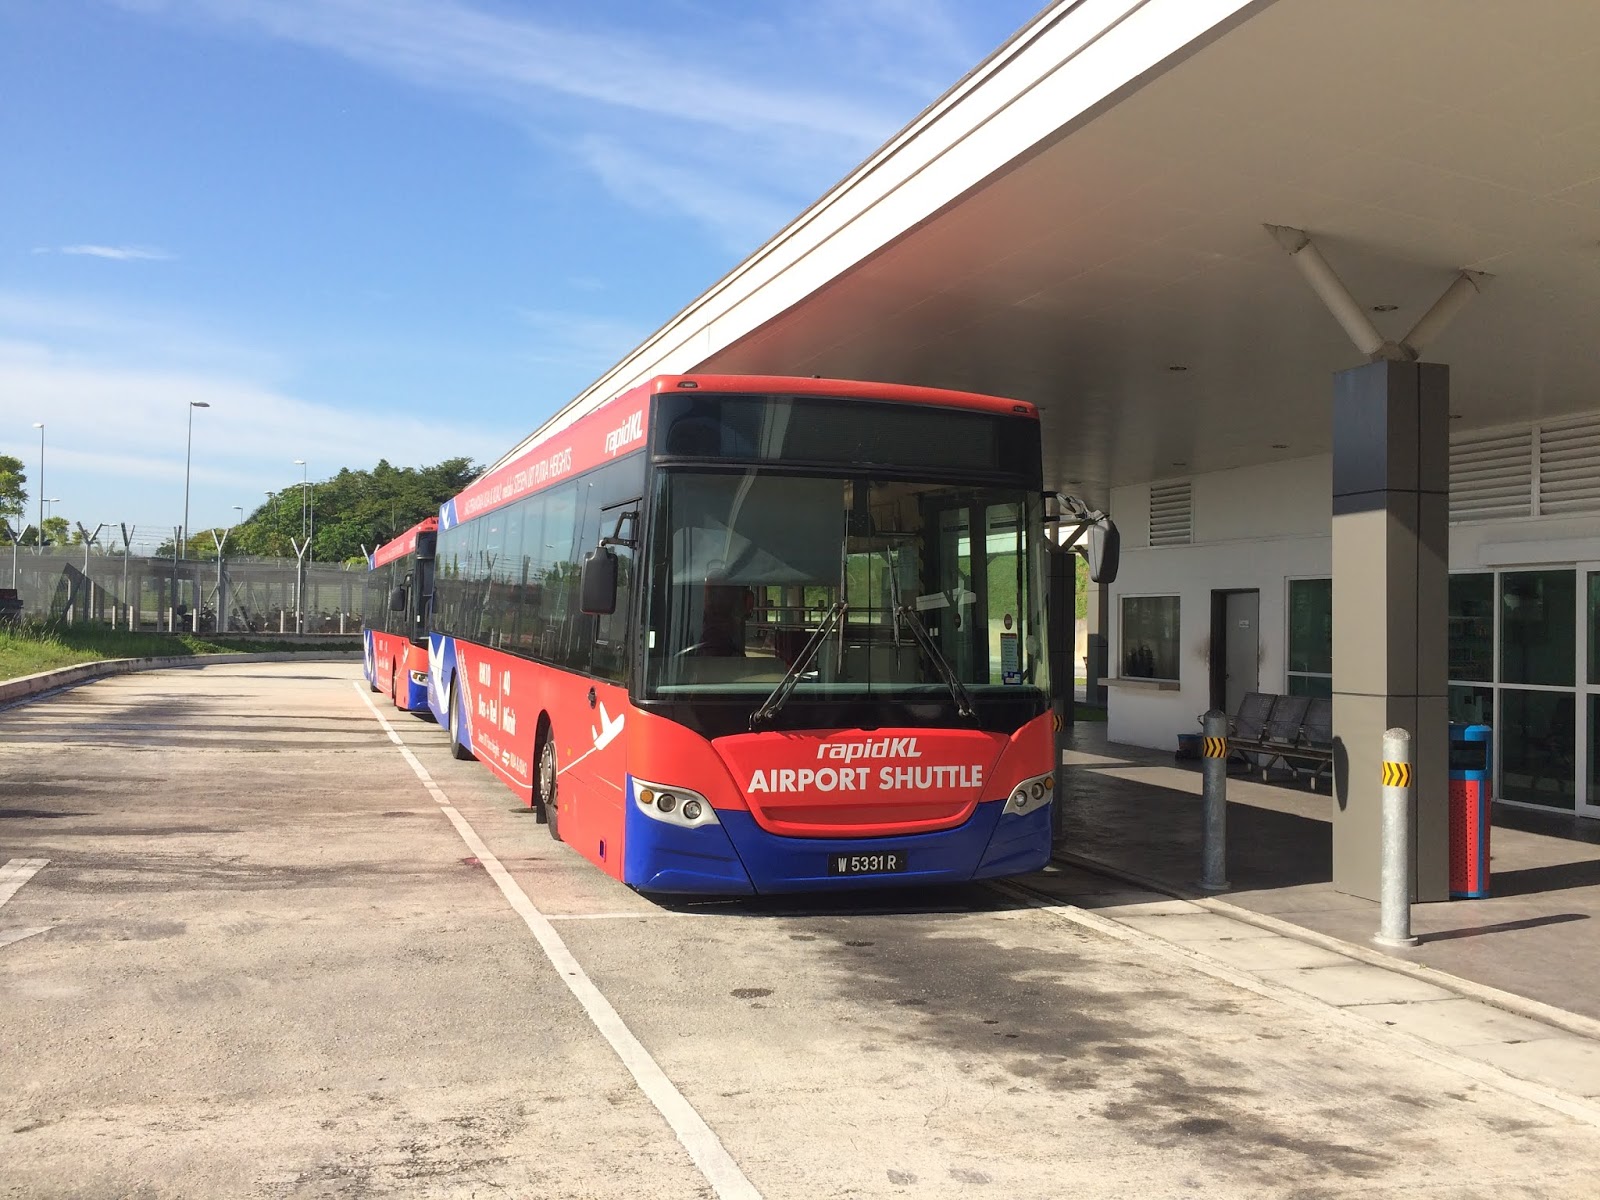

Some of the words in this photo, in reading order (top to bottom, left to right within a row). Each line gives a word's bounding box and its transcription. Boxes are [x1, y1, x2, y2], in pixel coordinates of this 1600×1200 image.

[605, 410, 643, 456] rapidKL
[535, 460, 549, 484] PUTRA
[549, 447, 572, 478] HEIGHTS
[817, 737, 923, 764] rapidKL
[747, 767, 871, 793] AIRPORT
[878, 765, 983, 790] SHUTTLE
[837, 857, 848, 873] W
[851, 855, 884, 872] 5331
[887, 854, 897, 870] R
